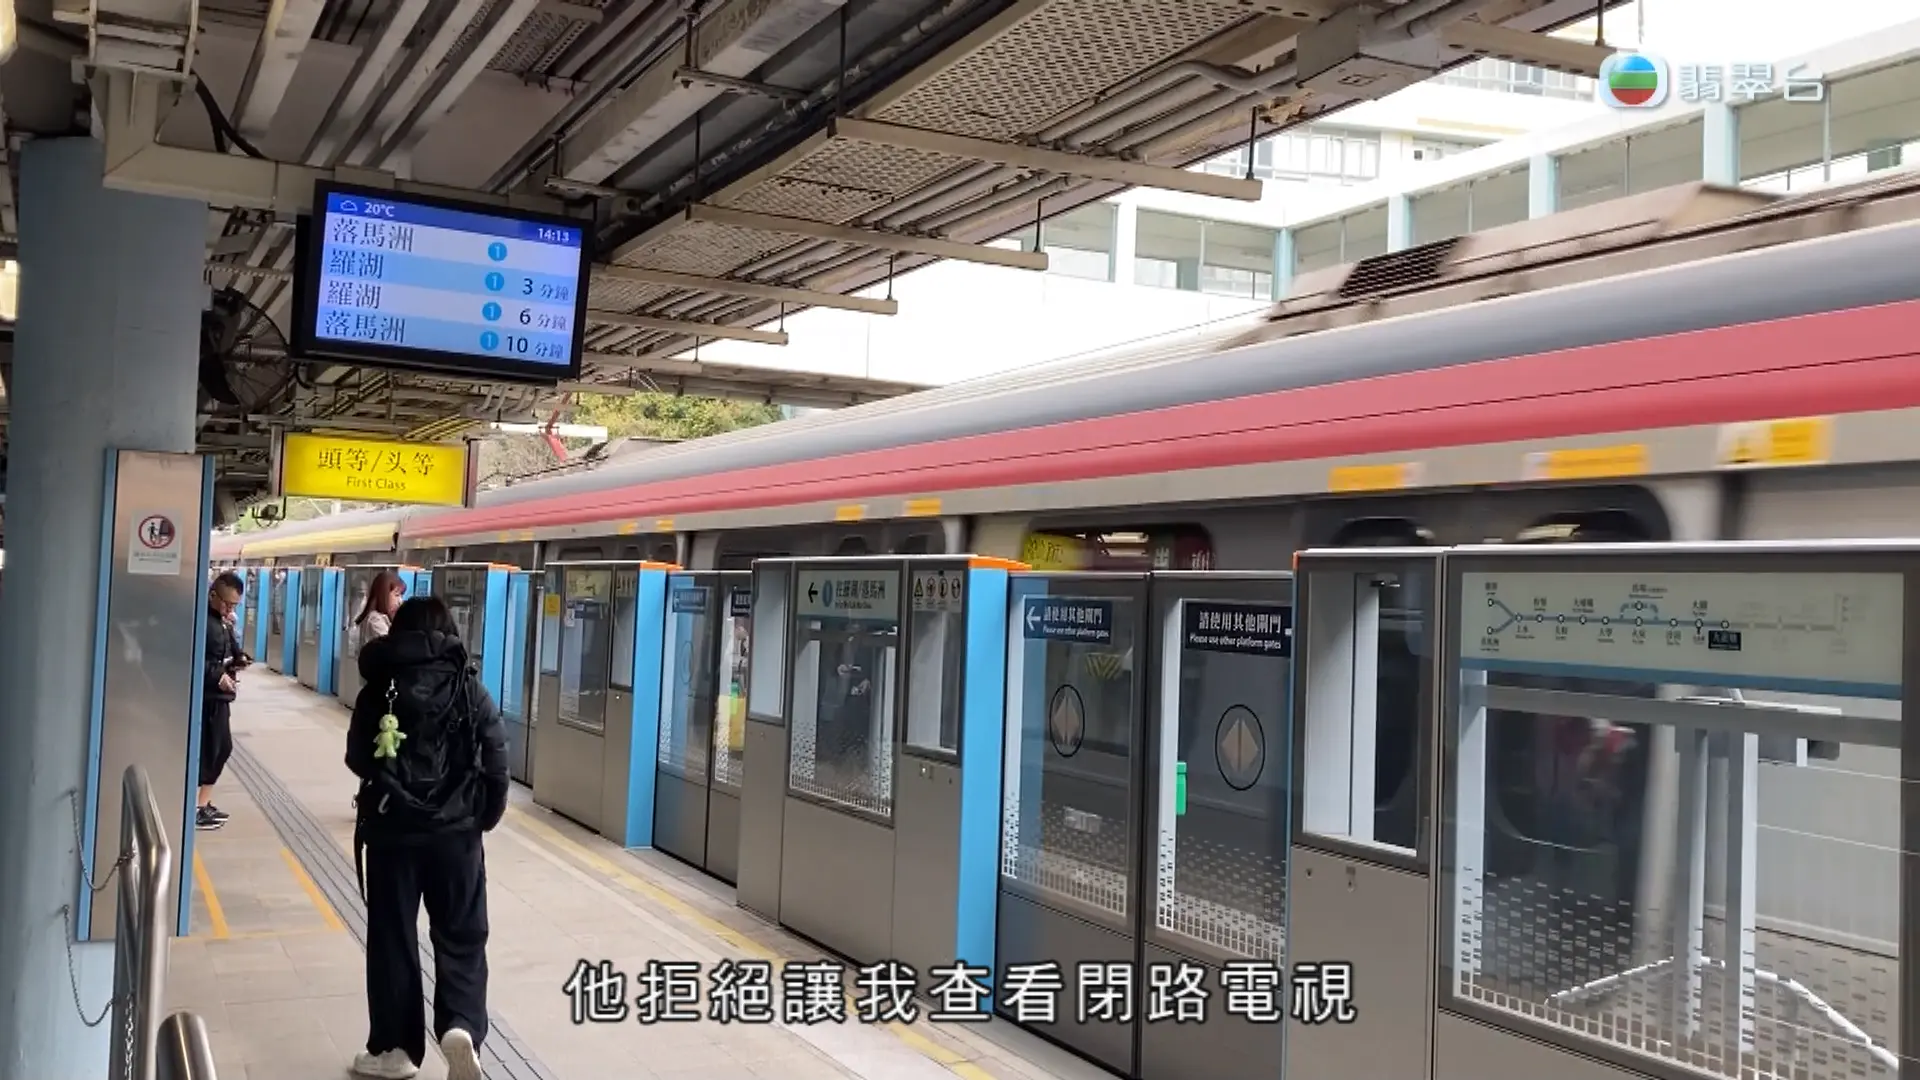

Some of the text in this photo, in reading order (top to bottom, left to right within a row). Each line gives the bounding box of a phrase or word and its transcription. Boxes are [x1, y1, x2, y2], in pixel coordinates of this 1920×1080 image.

[363, 202, 395, 217] 20°C
[333, 217, 414, 253] 落馬洲
[537, 228, 570, 242] 14:13
[329, 250, 384, 279] 羅湖
[522, 278, 533, 295] 3
[540, 283, 570, 301] 分鐘
[326, 280, 381, 309] 羅湖
[519, 308, 531, 325] 6
[537, 312, 567, 331] 分鐘
[324, 311, 406, 343] 落馬洲
[506, 336, 529, 354] 10
[534, 341, 564, 359] 分鐘
[317, 447, 436, 476] 頭等/头等
[346, 475, 407, 491] First Class
[1198, 610, 1282, 634] 請使用其他閘門
[1189, 633, 1282, 651] Please use other platform gates
